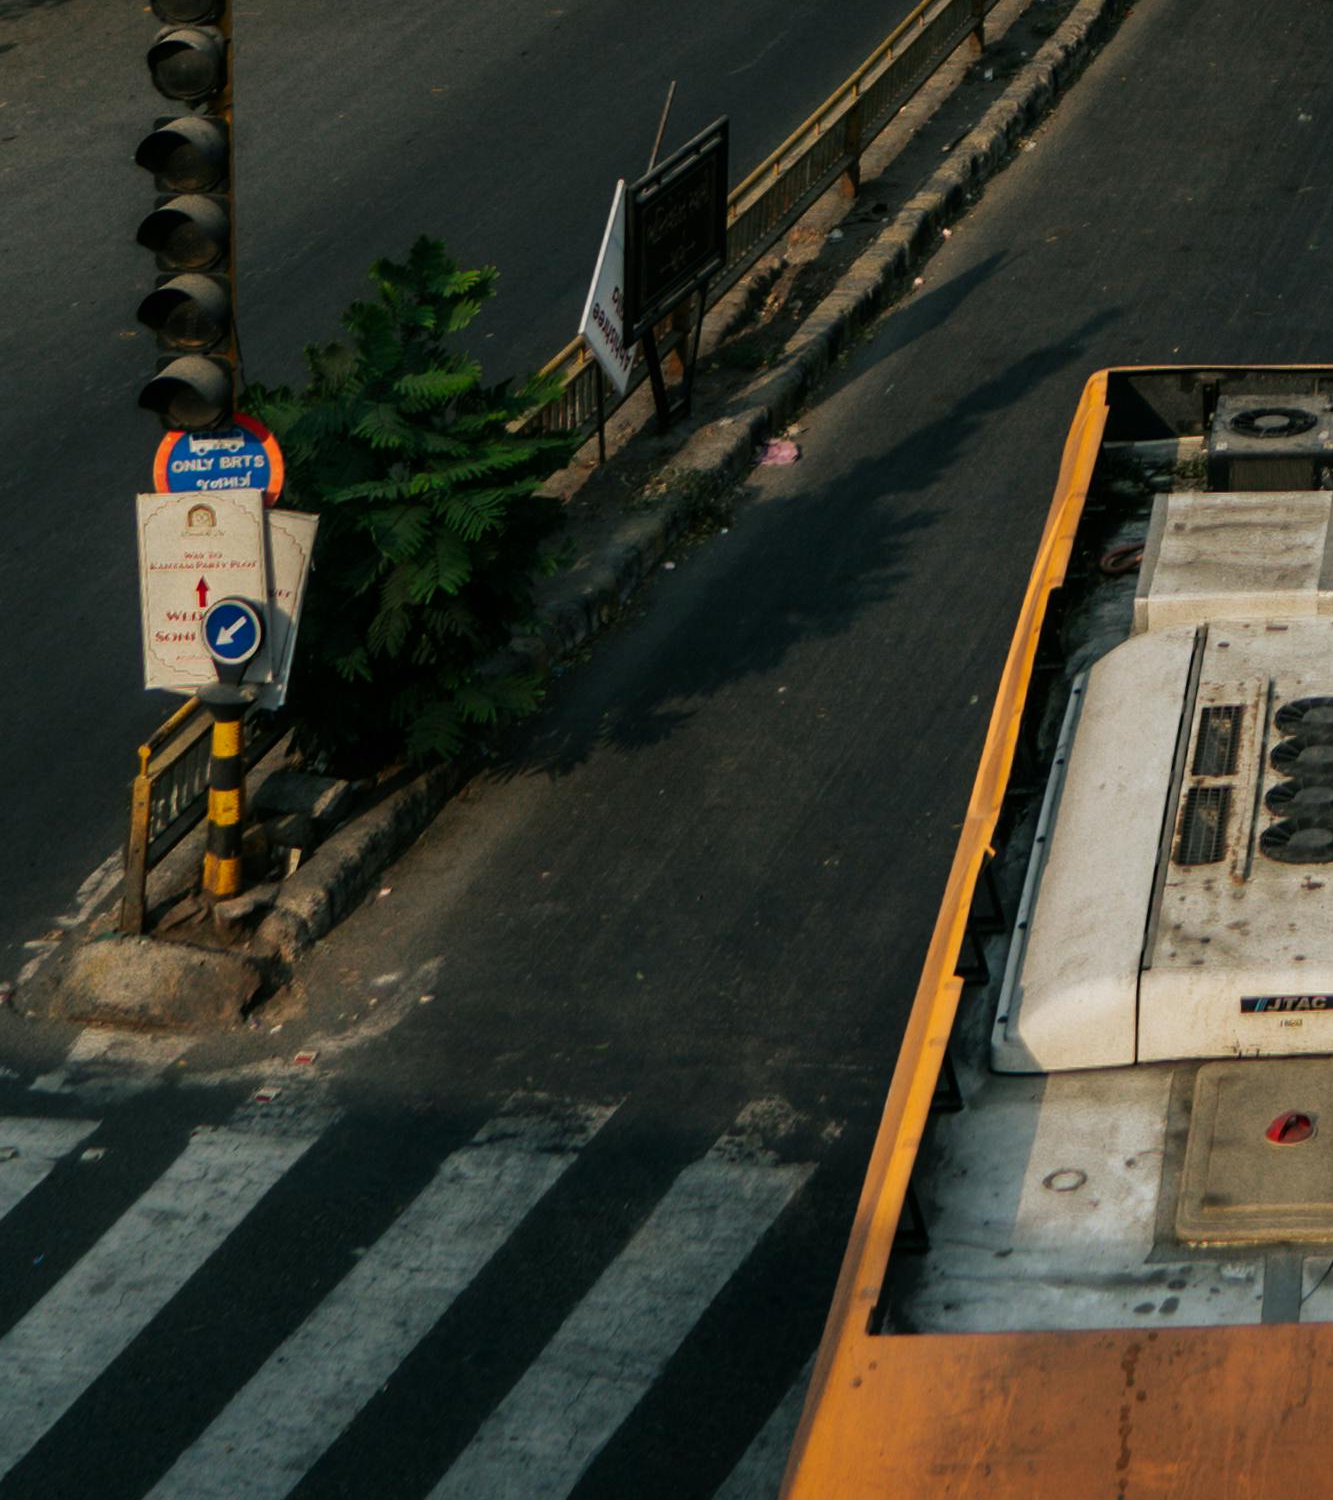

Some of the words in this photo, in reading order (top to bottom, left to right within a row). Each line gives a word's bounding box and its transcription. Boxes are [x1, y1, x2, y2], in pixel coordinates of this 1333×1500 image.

[171, 457, 214, 474] ONLY
[219, 454, 265, 470] BRTS
[1267, 996, 1328, 1011] JTAC
